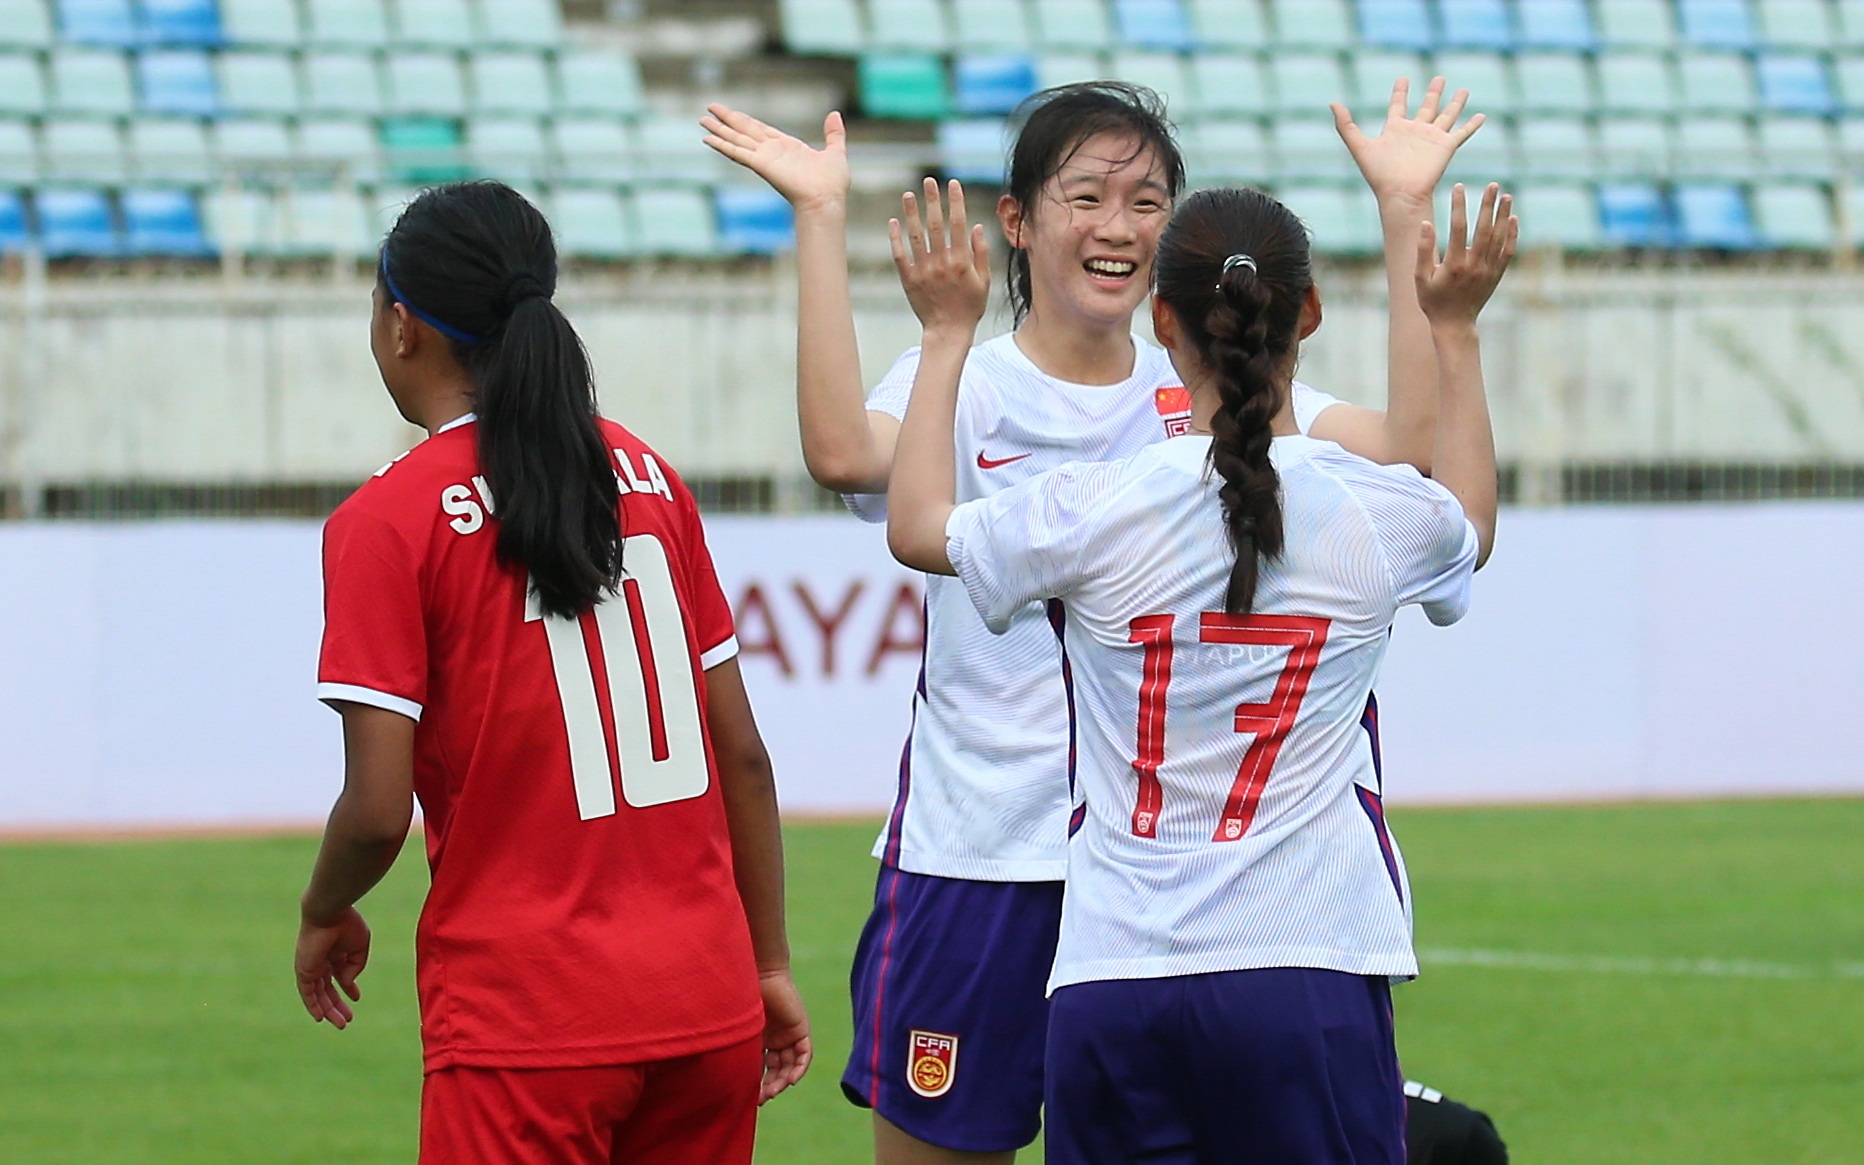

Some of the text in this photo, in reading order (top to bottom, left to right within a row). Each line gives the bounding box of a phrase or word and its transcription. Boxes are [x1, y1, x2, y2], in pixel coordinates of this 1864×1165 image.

[1172, 422, 1191, 435] CF
[524, 533, 710, 821] 10
[1128, 612, 1332, 842] 17
[916, 1036, 950, 1051] CFA
